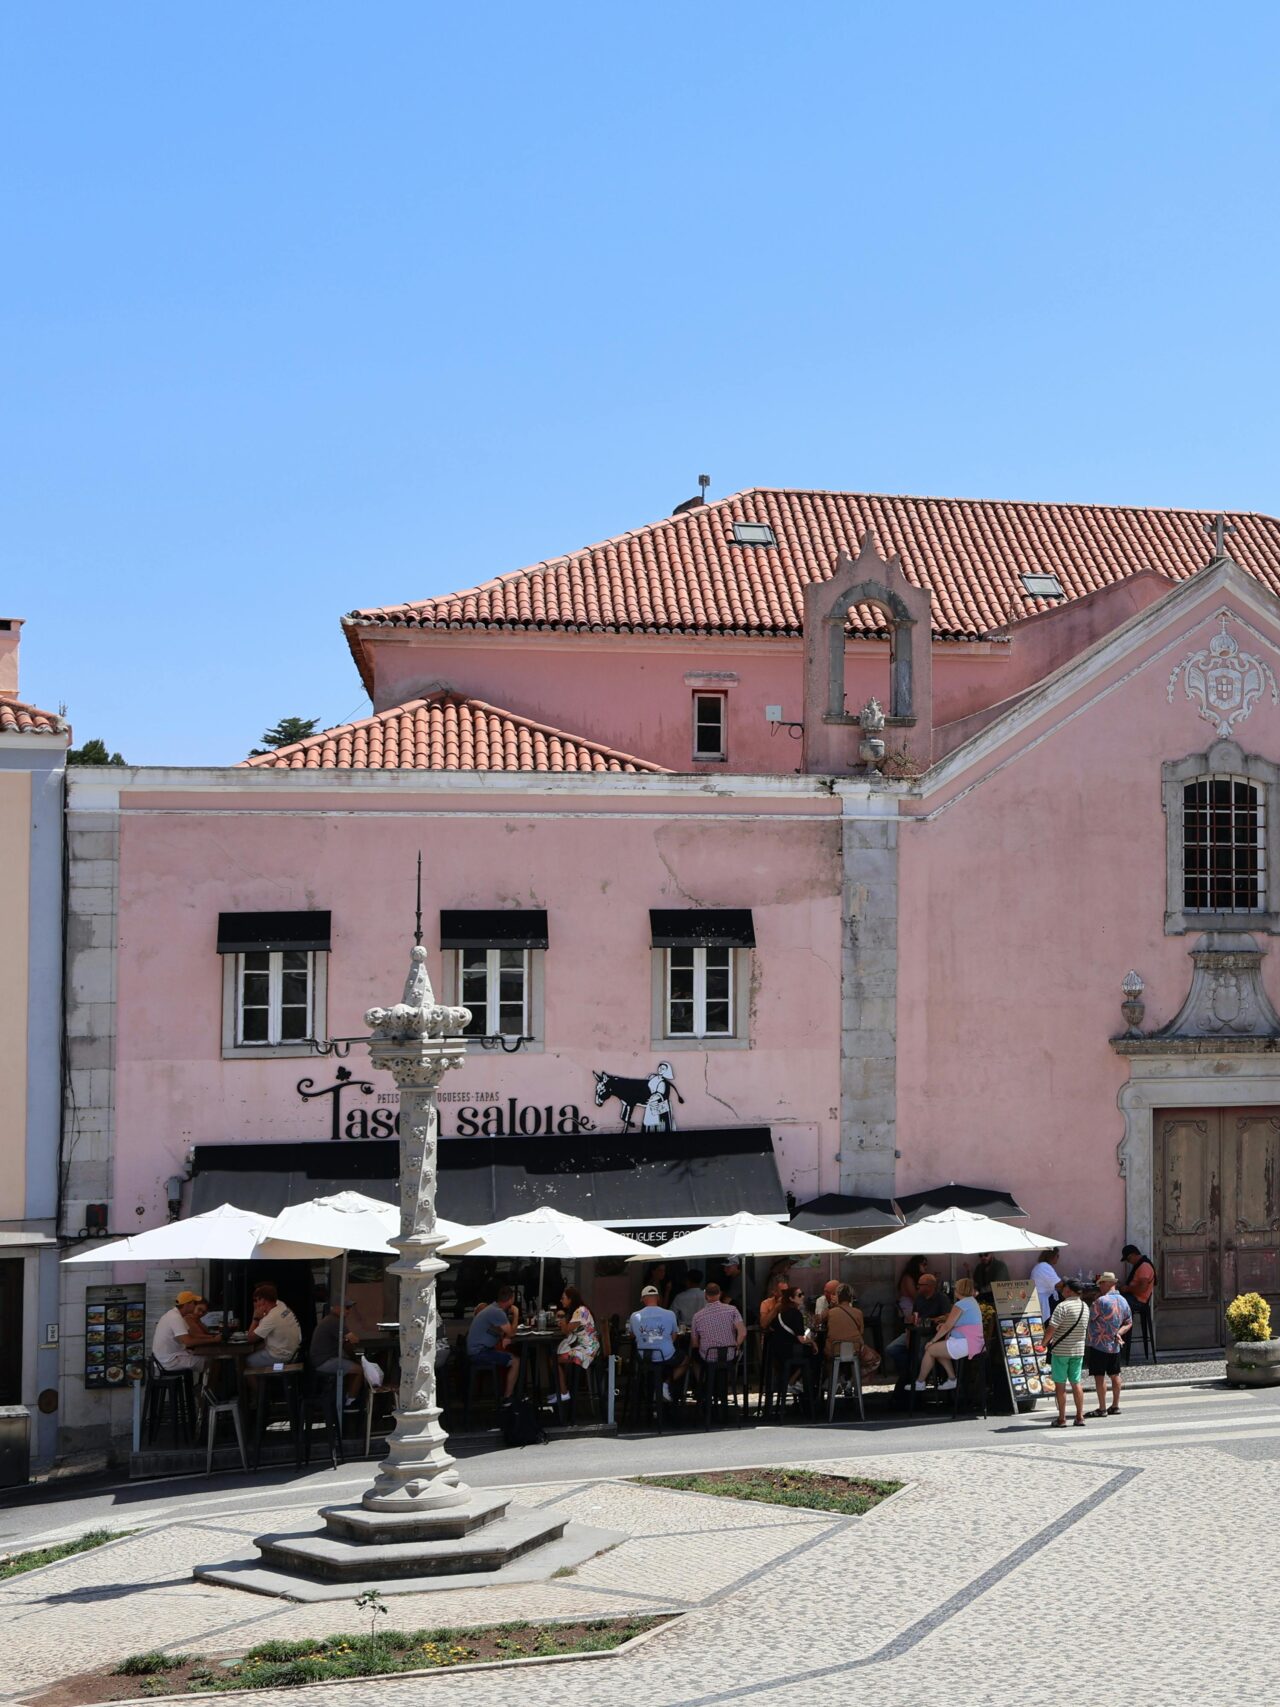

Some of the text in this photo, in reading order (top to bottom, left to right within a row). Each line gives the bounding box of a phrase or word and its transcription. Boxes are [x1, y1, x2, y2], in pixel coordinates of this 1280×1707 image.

[377, 1091, 500, 1104] PETIS UGUESES TAPAS
[297, 1078, 597, 1140] Tas saloia
[673, 1231, 691, 1239] FOO
